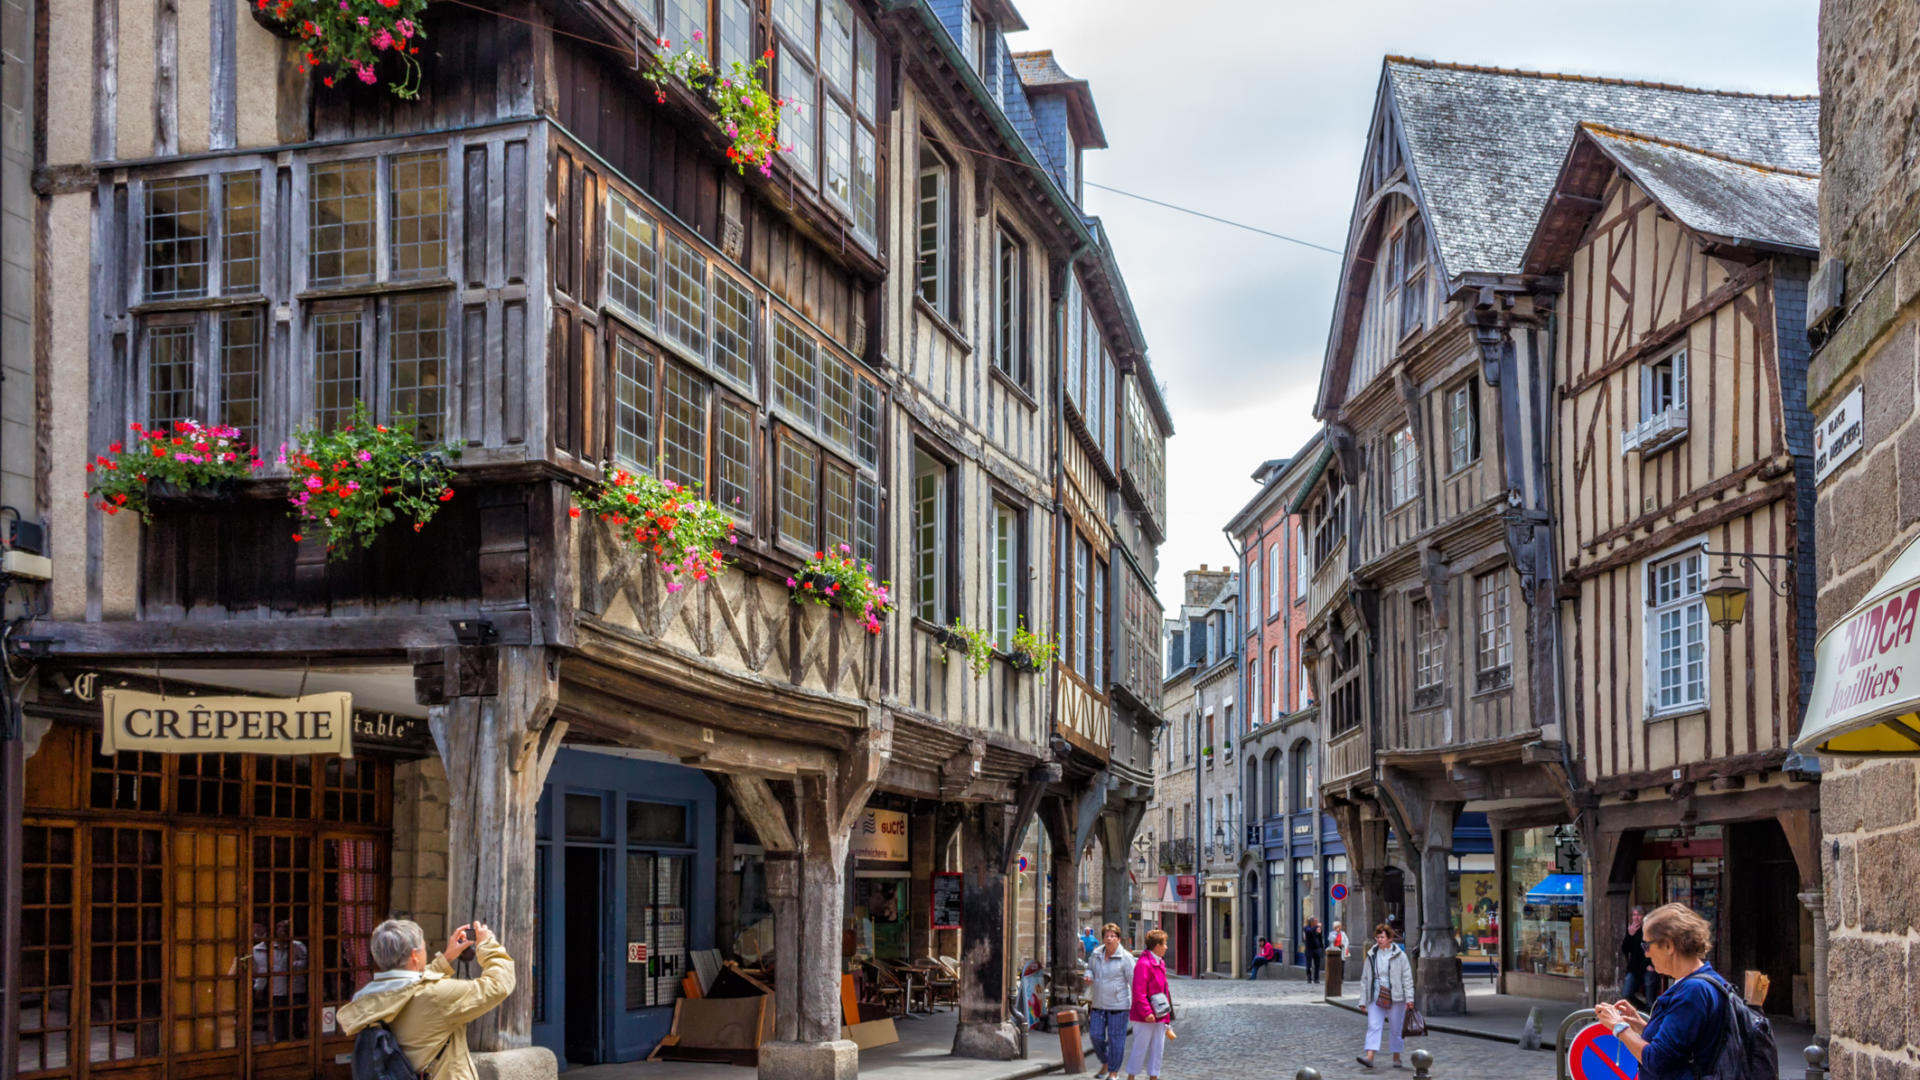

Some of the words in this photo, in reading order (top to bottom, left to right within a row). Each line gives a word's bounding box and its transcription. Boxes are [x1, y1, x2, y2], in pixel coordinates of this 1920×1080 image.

[1828, 408, 1845, 435] PLACE
[1825, 663, 1903, 719] Joailliers
[124, 704, 333, 741] CRÊPERIE
[881, 814, 905, 836] sucré
